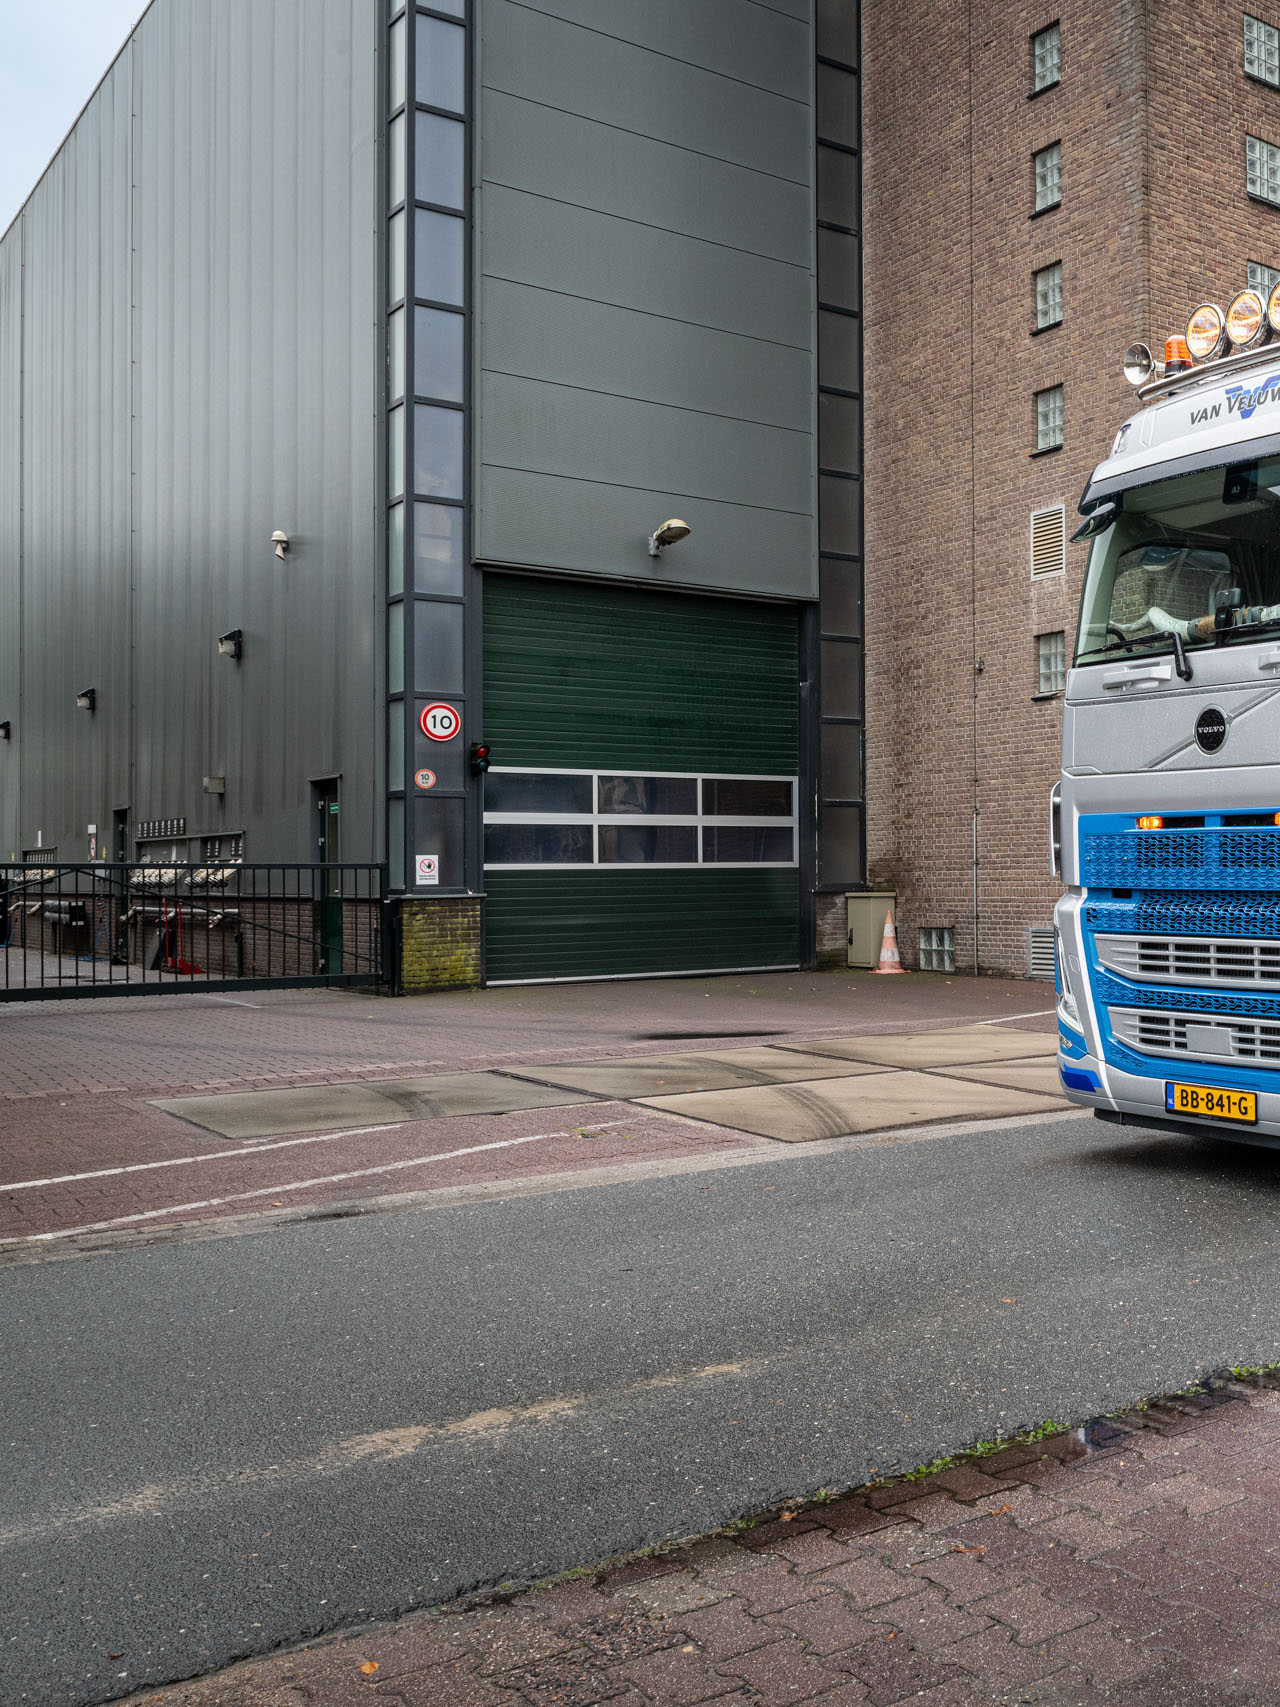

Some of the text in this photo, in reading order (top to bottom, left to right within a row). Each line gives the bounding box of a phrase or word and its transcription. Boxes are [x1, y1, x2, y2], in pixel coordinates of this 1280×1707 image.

[1190, 403, 1221, 425] VAN
[431, 715, 452, 730] 10
[1197, 725, 1225, 734] VOLVO
[1180, 1088, 1249, 1116] BB-841-G
